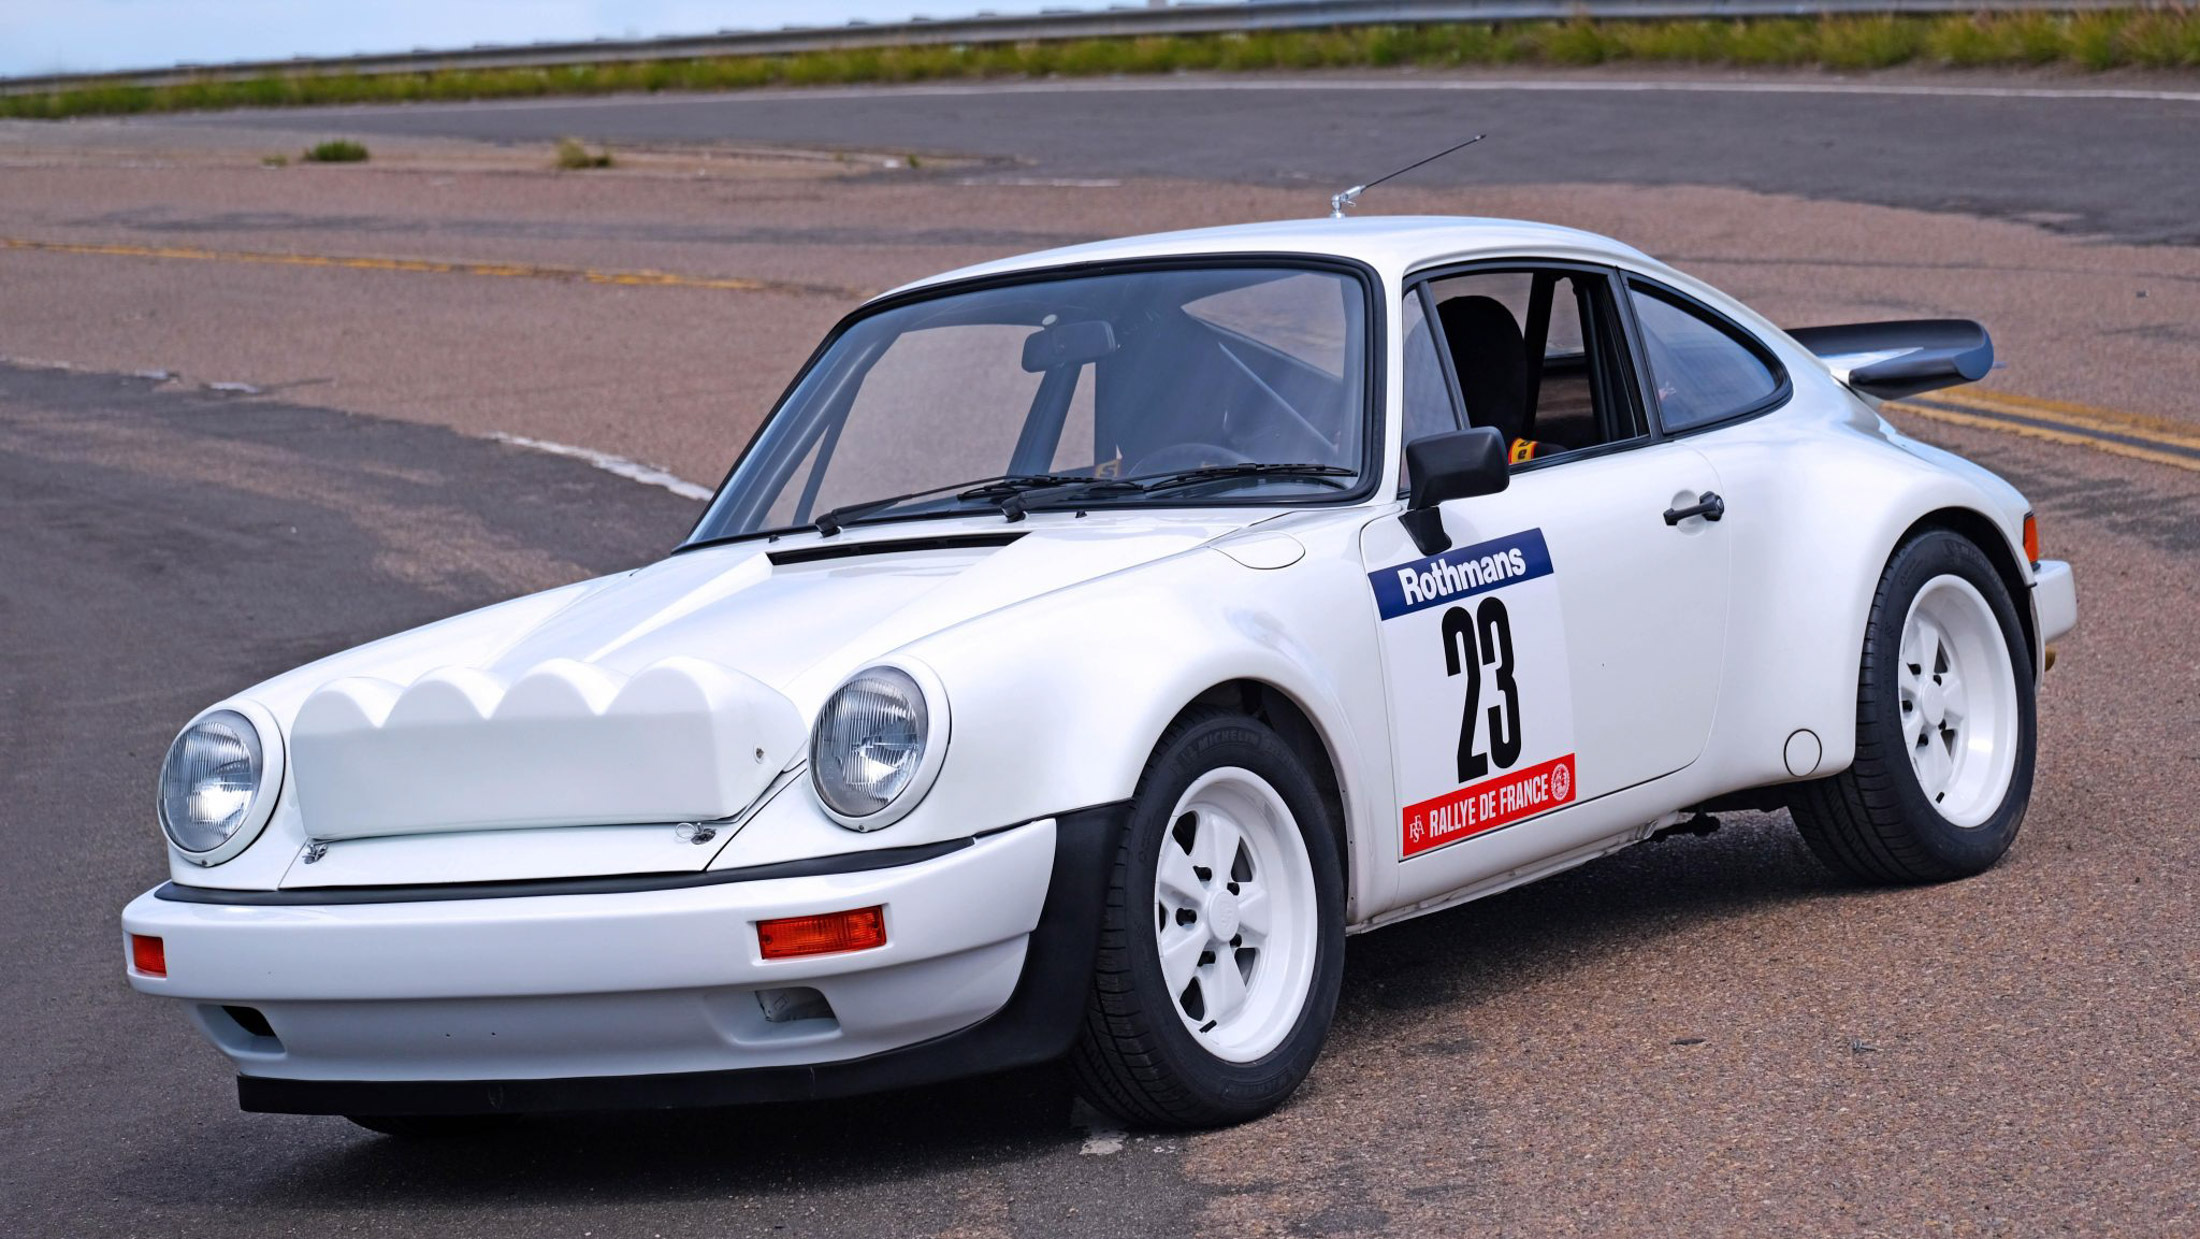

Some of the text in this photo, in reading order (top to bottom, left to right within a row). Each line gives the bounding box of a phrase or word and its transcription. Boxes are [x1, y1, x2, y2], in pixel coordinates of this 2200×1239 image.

[1397, 548, 1526, 606] Rothmans
[1441, 596, 1522, 784] 23
[1429, 796, 1476, 838] RALLYE
[1479, 790, 1496, 822] DE
[1500, 773, 1549, 815] FRANCE
